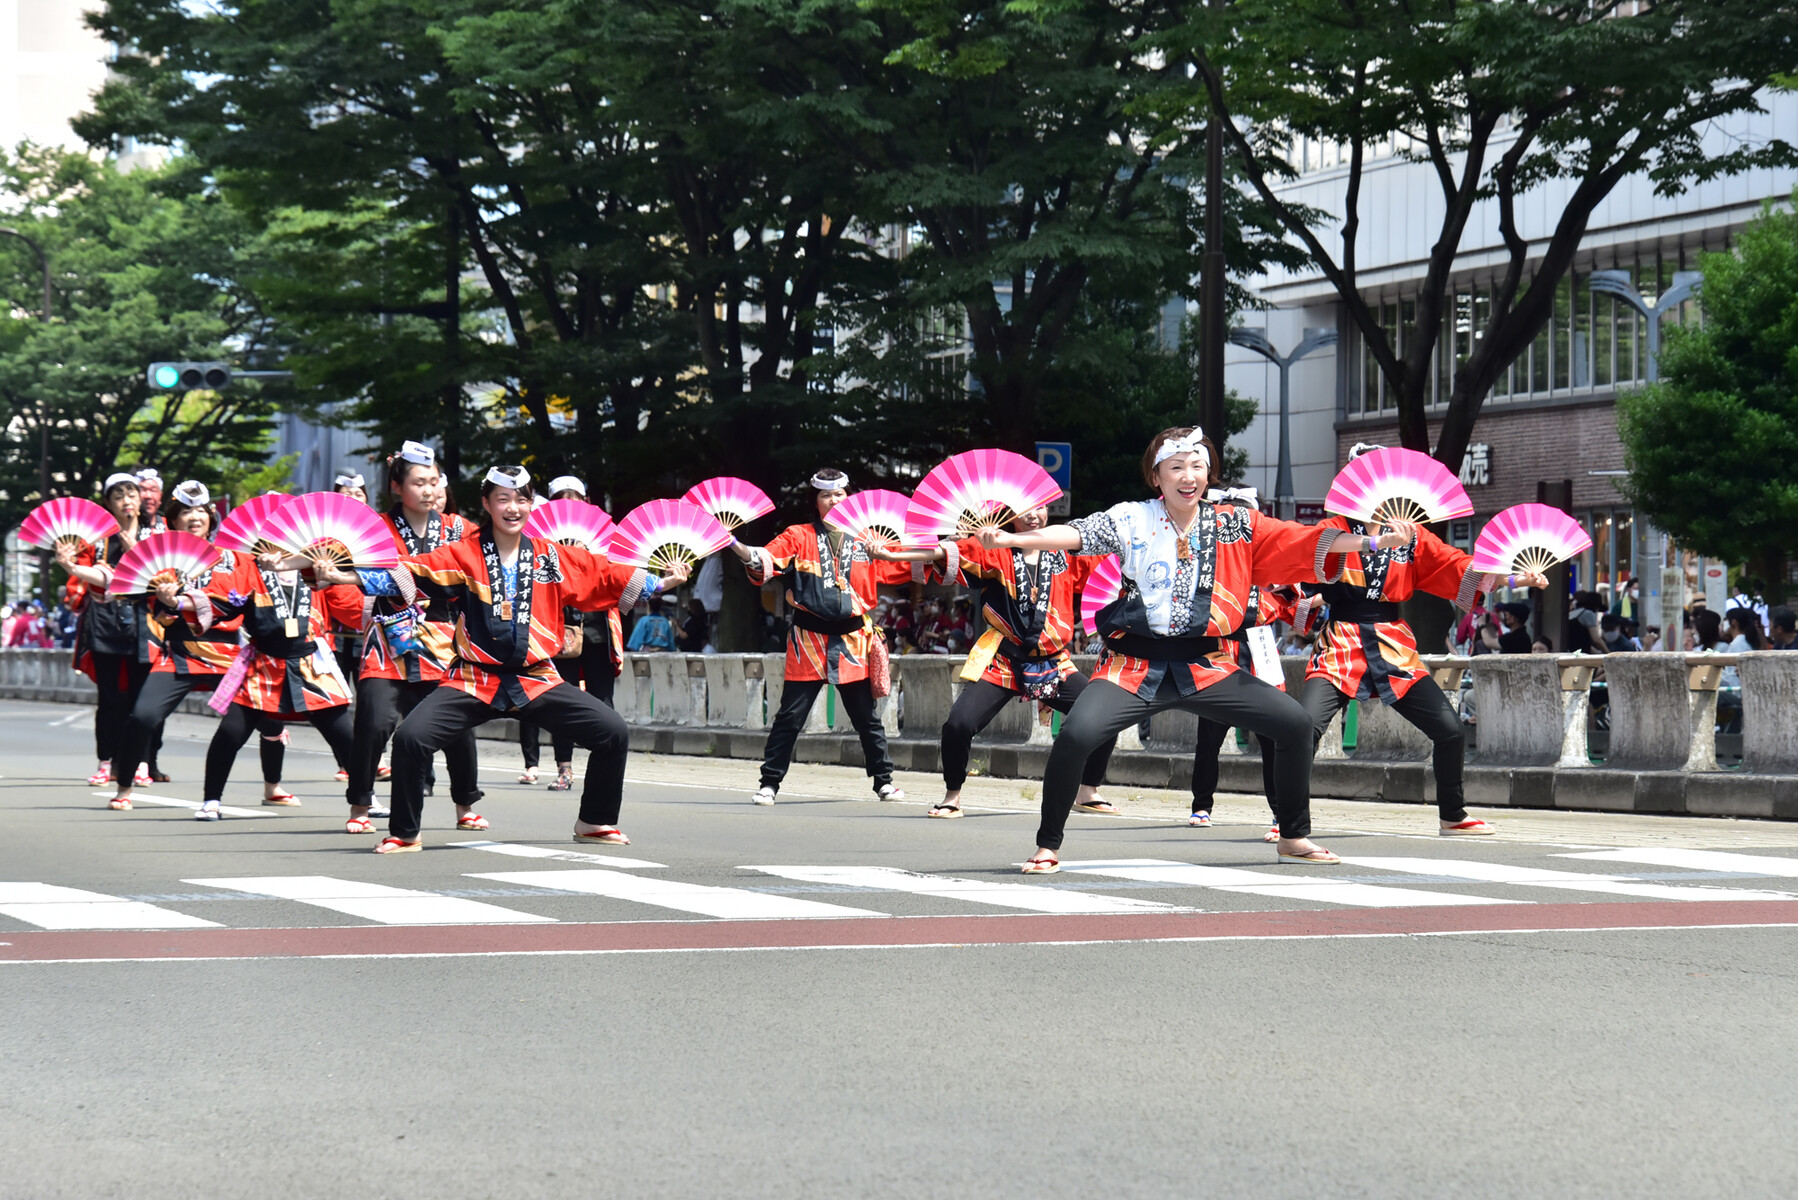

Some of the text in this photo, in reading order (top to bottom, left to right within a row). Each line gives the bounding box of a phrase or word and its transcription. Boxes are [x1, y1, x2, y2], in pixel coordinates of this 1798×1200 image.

[516, 549, 533, 624] 沖野すずめ隊
[1199, 507, 1216, 589] 沖野すずめ隊
